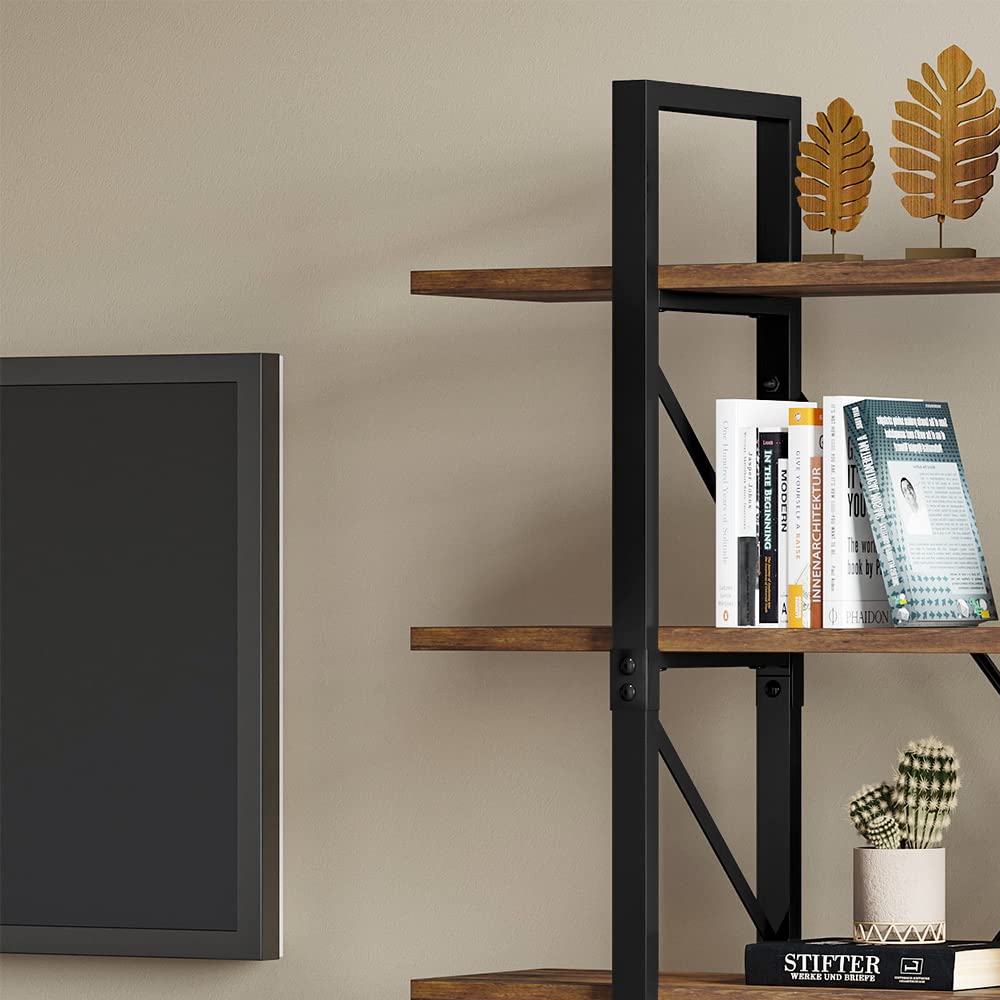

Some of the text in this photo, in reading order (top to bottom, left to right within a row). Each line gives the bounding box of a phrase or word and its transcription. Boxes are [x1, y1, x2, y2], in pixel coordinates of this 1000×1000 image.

[764, 450, 772, 464] IN
[764, 466, 772, 488] THE
[764, 490, 772, 550] BEGINNING
[812, 467, 821, 603] INNENARCHITEKTUR
[848, 537, 858, 553] The
[846, 610, 889, 624] PHAIDON
[784, 953, 880, 974] STIFTER
[844, 974, 876, 982] BRIEFE
